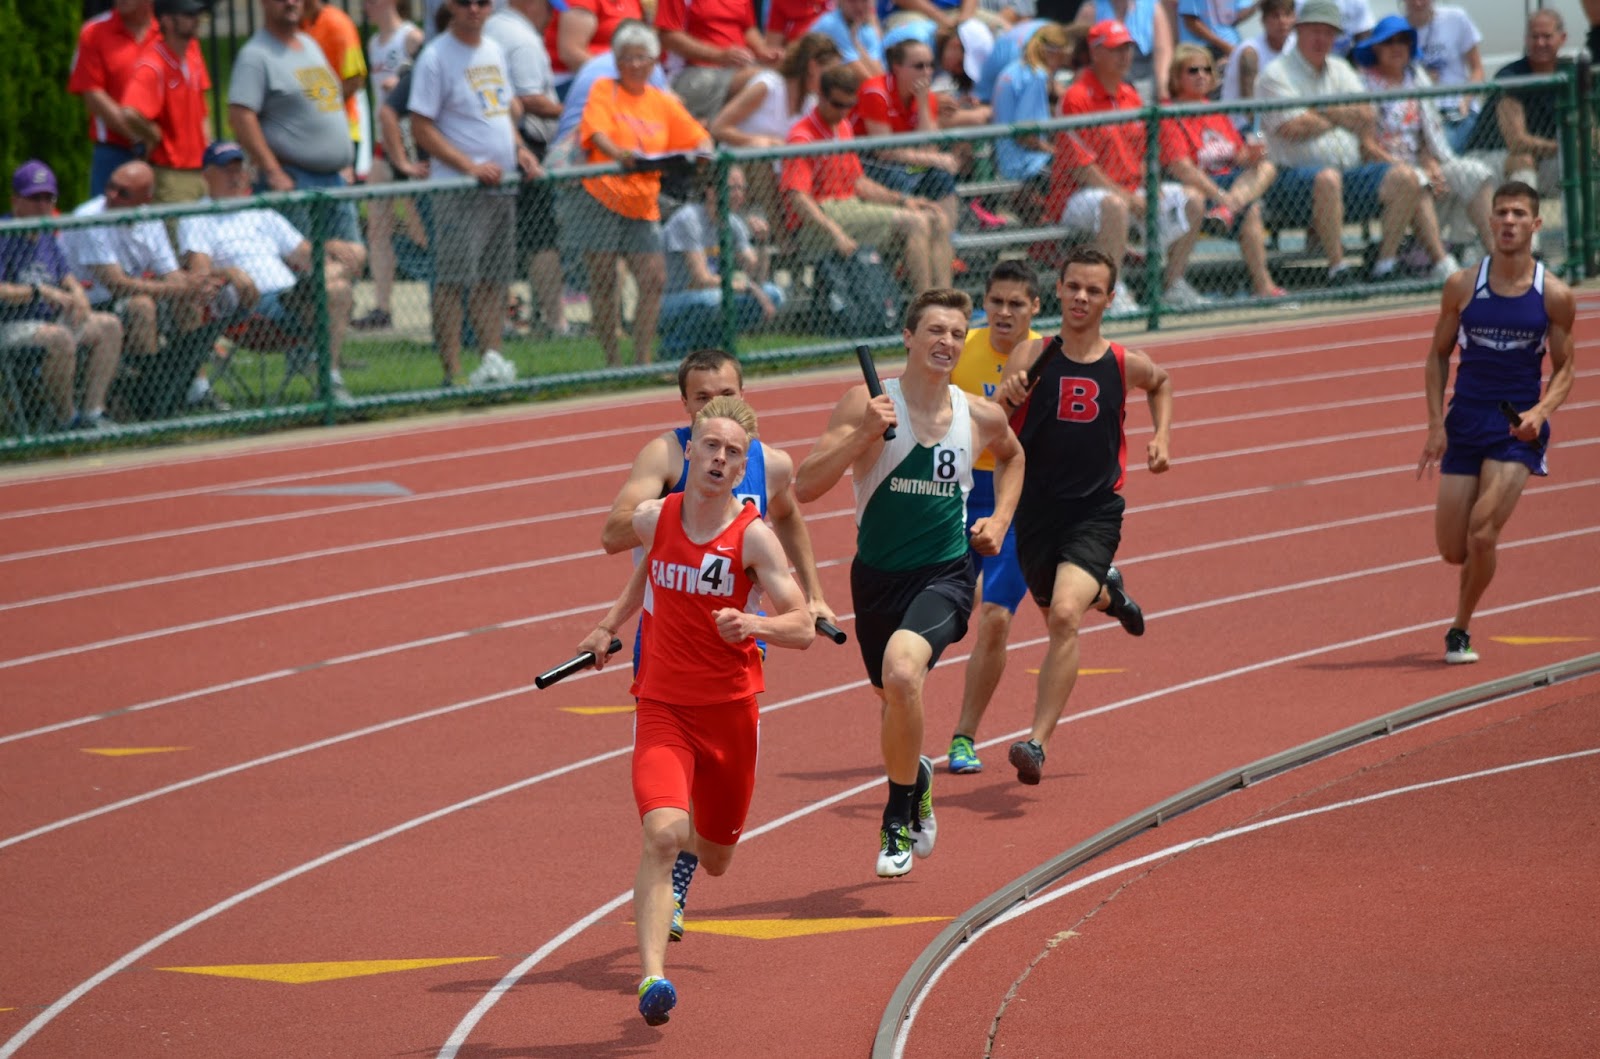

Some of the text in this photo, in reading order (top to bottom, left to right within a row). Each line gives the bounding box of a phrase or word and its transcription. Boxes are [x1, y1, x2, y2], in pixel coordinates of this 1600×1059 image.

[1056, 376, 1100, 423] B
[937, 449, 956, 480] 8
[889, 476, 957, 498] SMITHVILLE
[651, 559, 735, 597] EASTWD
[701, 557, 724, 590] 4
